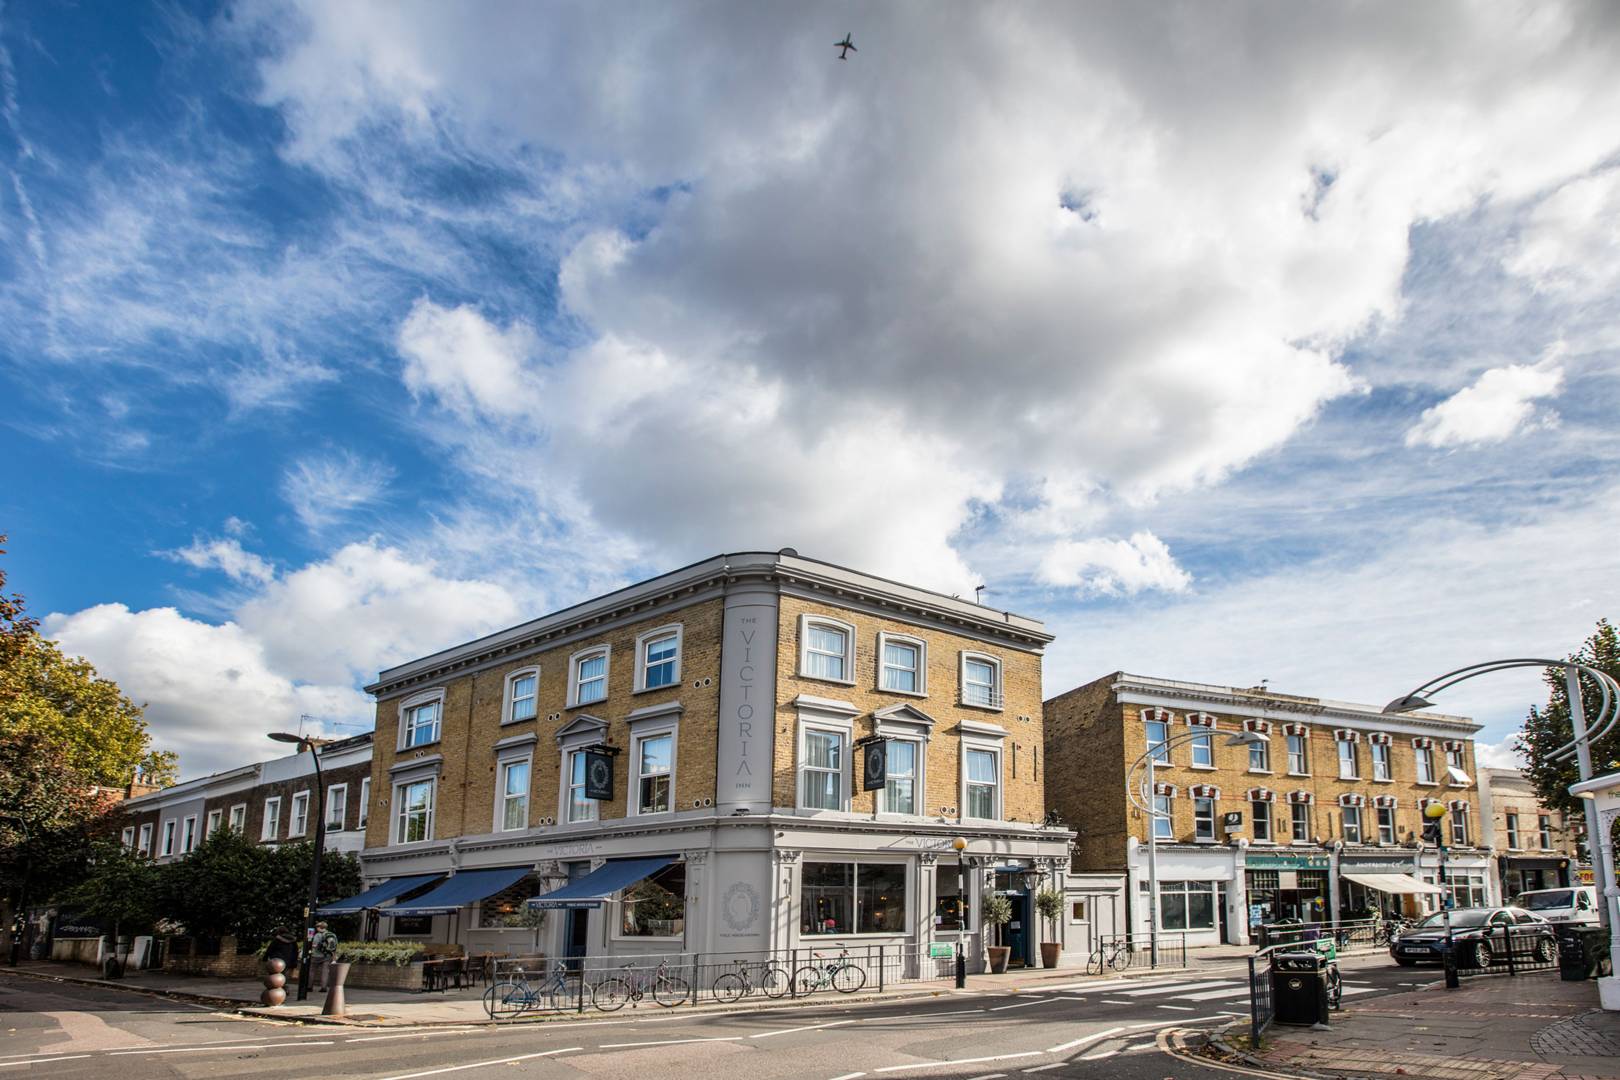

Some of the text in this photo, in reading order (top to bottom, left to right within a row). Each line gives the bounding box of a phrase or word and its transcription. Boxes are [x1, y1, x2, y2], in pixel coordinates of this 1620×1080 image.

[736, 629, 756, 776] VICTORIA
[552, 840, 594, 856] VICTORIA
[914, 838, 953, 849] VICTOR
